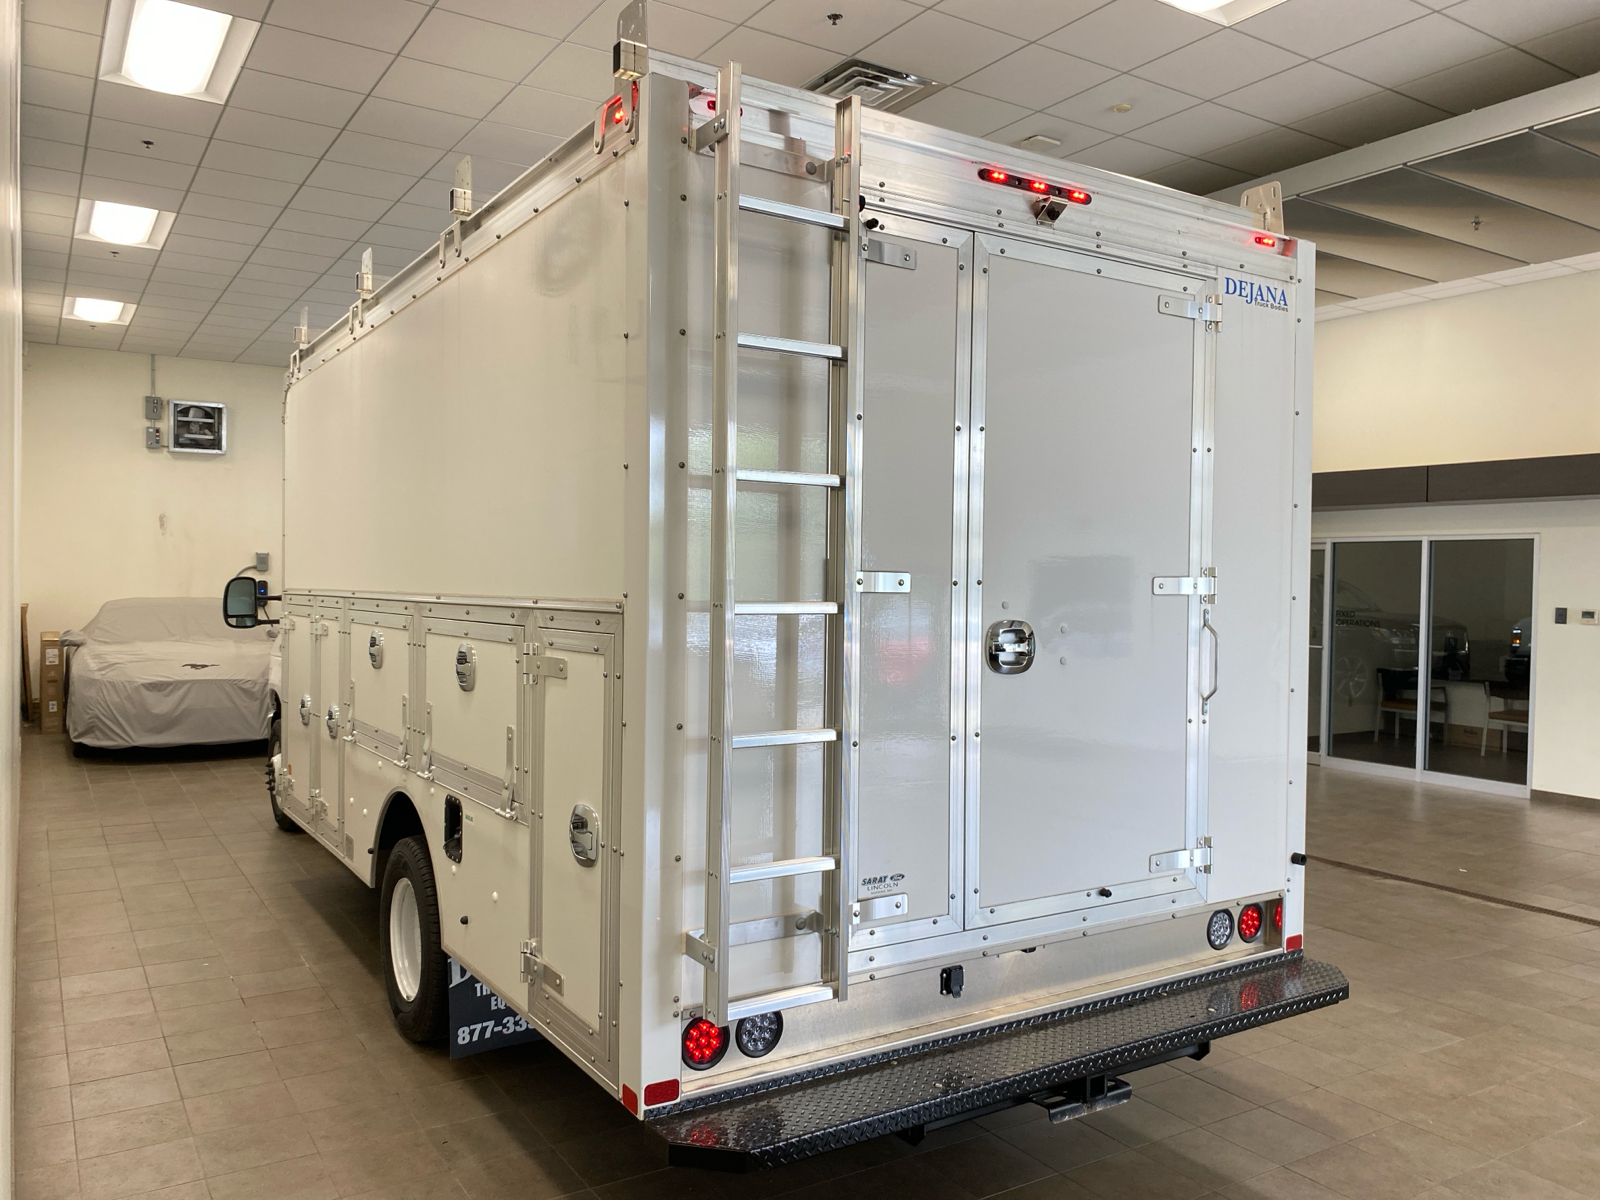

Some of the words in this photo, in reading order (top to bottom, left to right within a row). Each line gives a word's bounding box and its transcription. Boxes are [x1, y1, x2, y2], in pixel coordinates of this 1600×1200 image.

[1224, 276, 1289, 307] DEJANA
[1254, 299, 1270, 309] Truck
[1270, 302, 1289, 312] Bodies
[1335, 610, 1356, 618] FIXED
[1335, 618, 1381, 627] OPERATIONS
[861, 875, 888, 886] SARAT
[867, 882, 899, 891] LINCOLN
